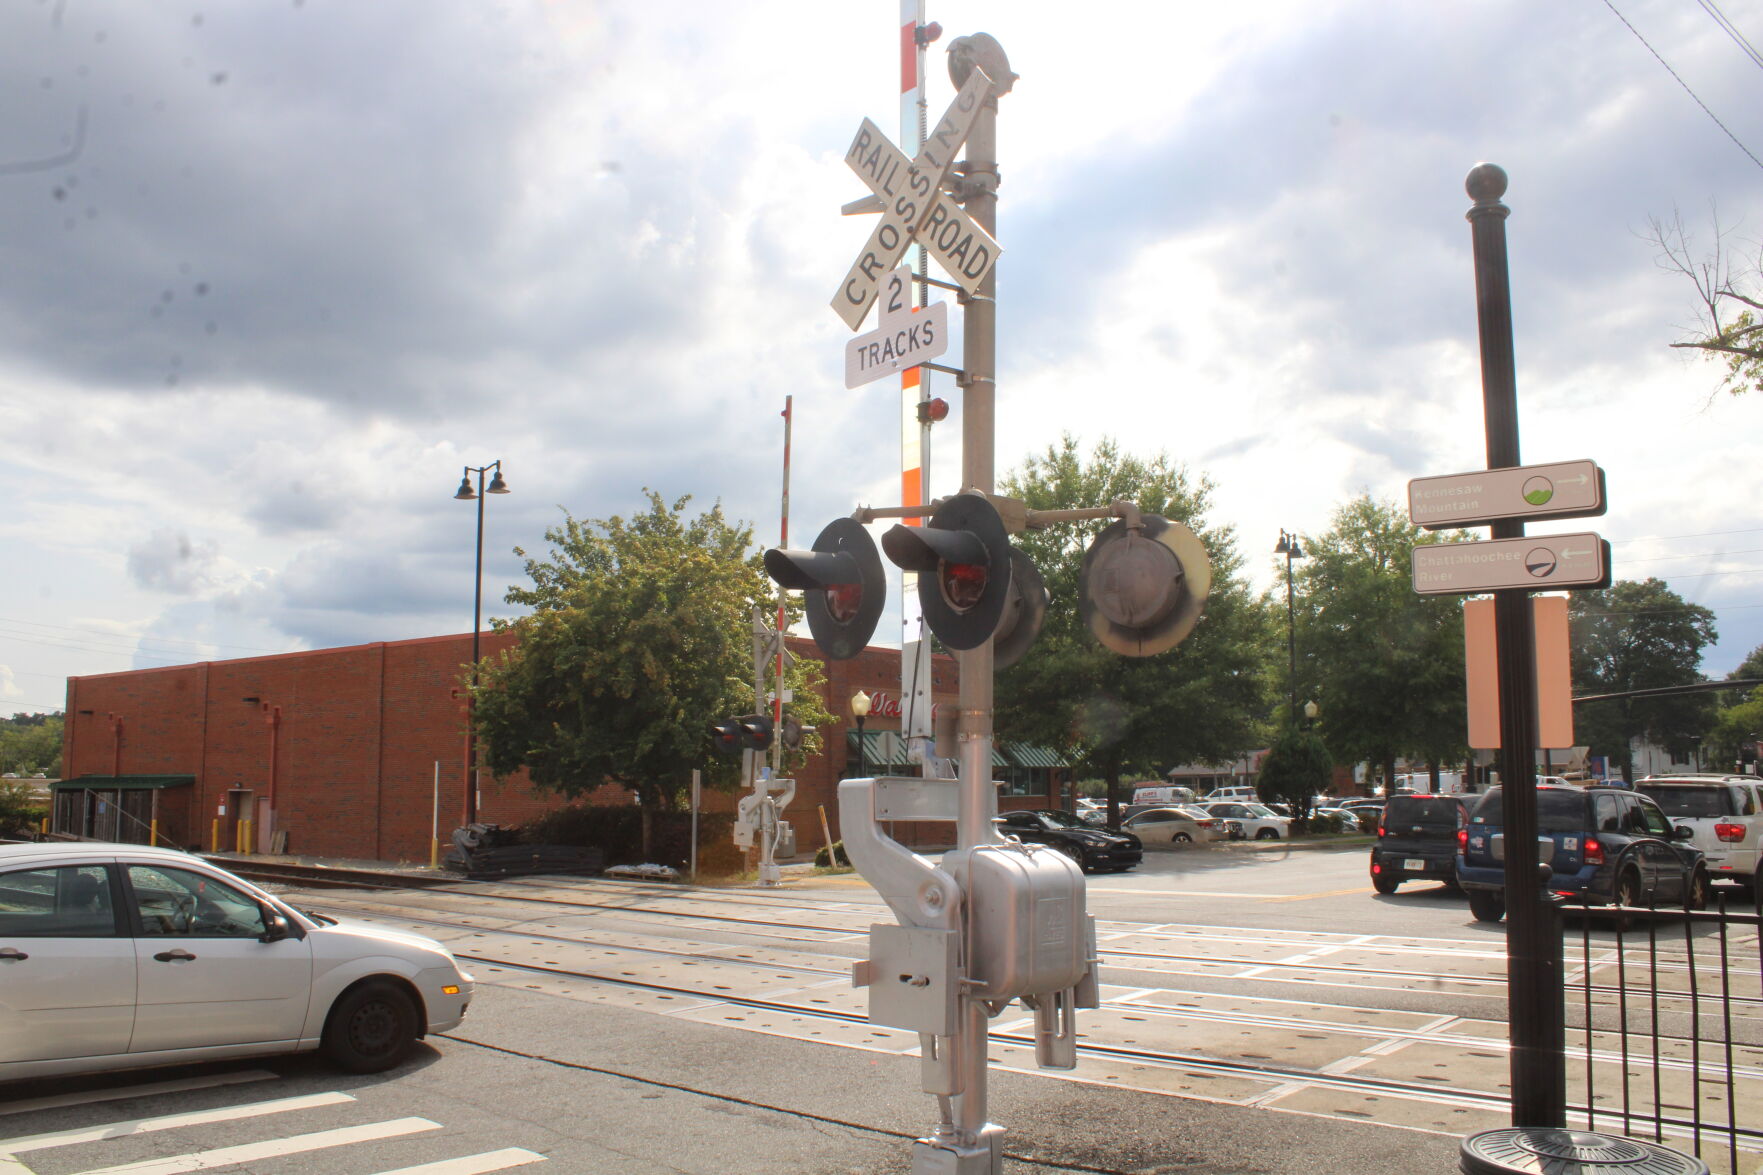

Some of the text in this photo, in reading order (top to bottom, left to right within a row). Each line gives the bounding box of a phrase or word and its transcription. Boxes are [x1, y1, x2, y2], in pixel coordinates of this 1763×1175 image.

[851, 128, 901, 198] RAIL
[845, 91, 976, 306] CROSSING
[922, 202, 989, 280] ROAD
[887, 276, 903, 314] 2
[857, 319, 935, 372] TRACKS
[1415, 484, 1483, 499] Kennesaw
[1415, 500, 1480, 514] Mountain
[1419, 571, 1453, 582] River
